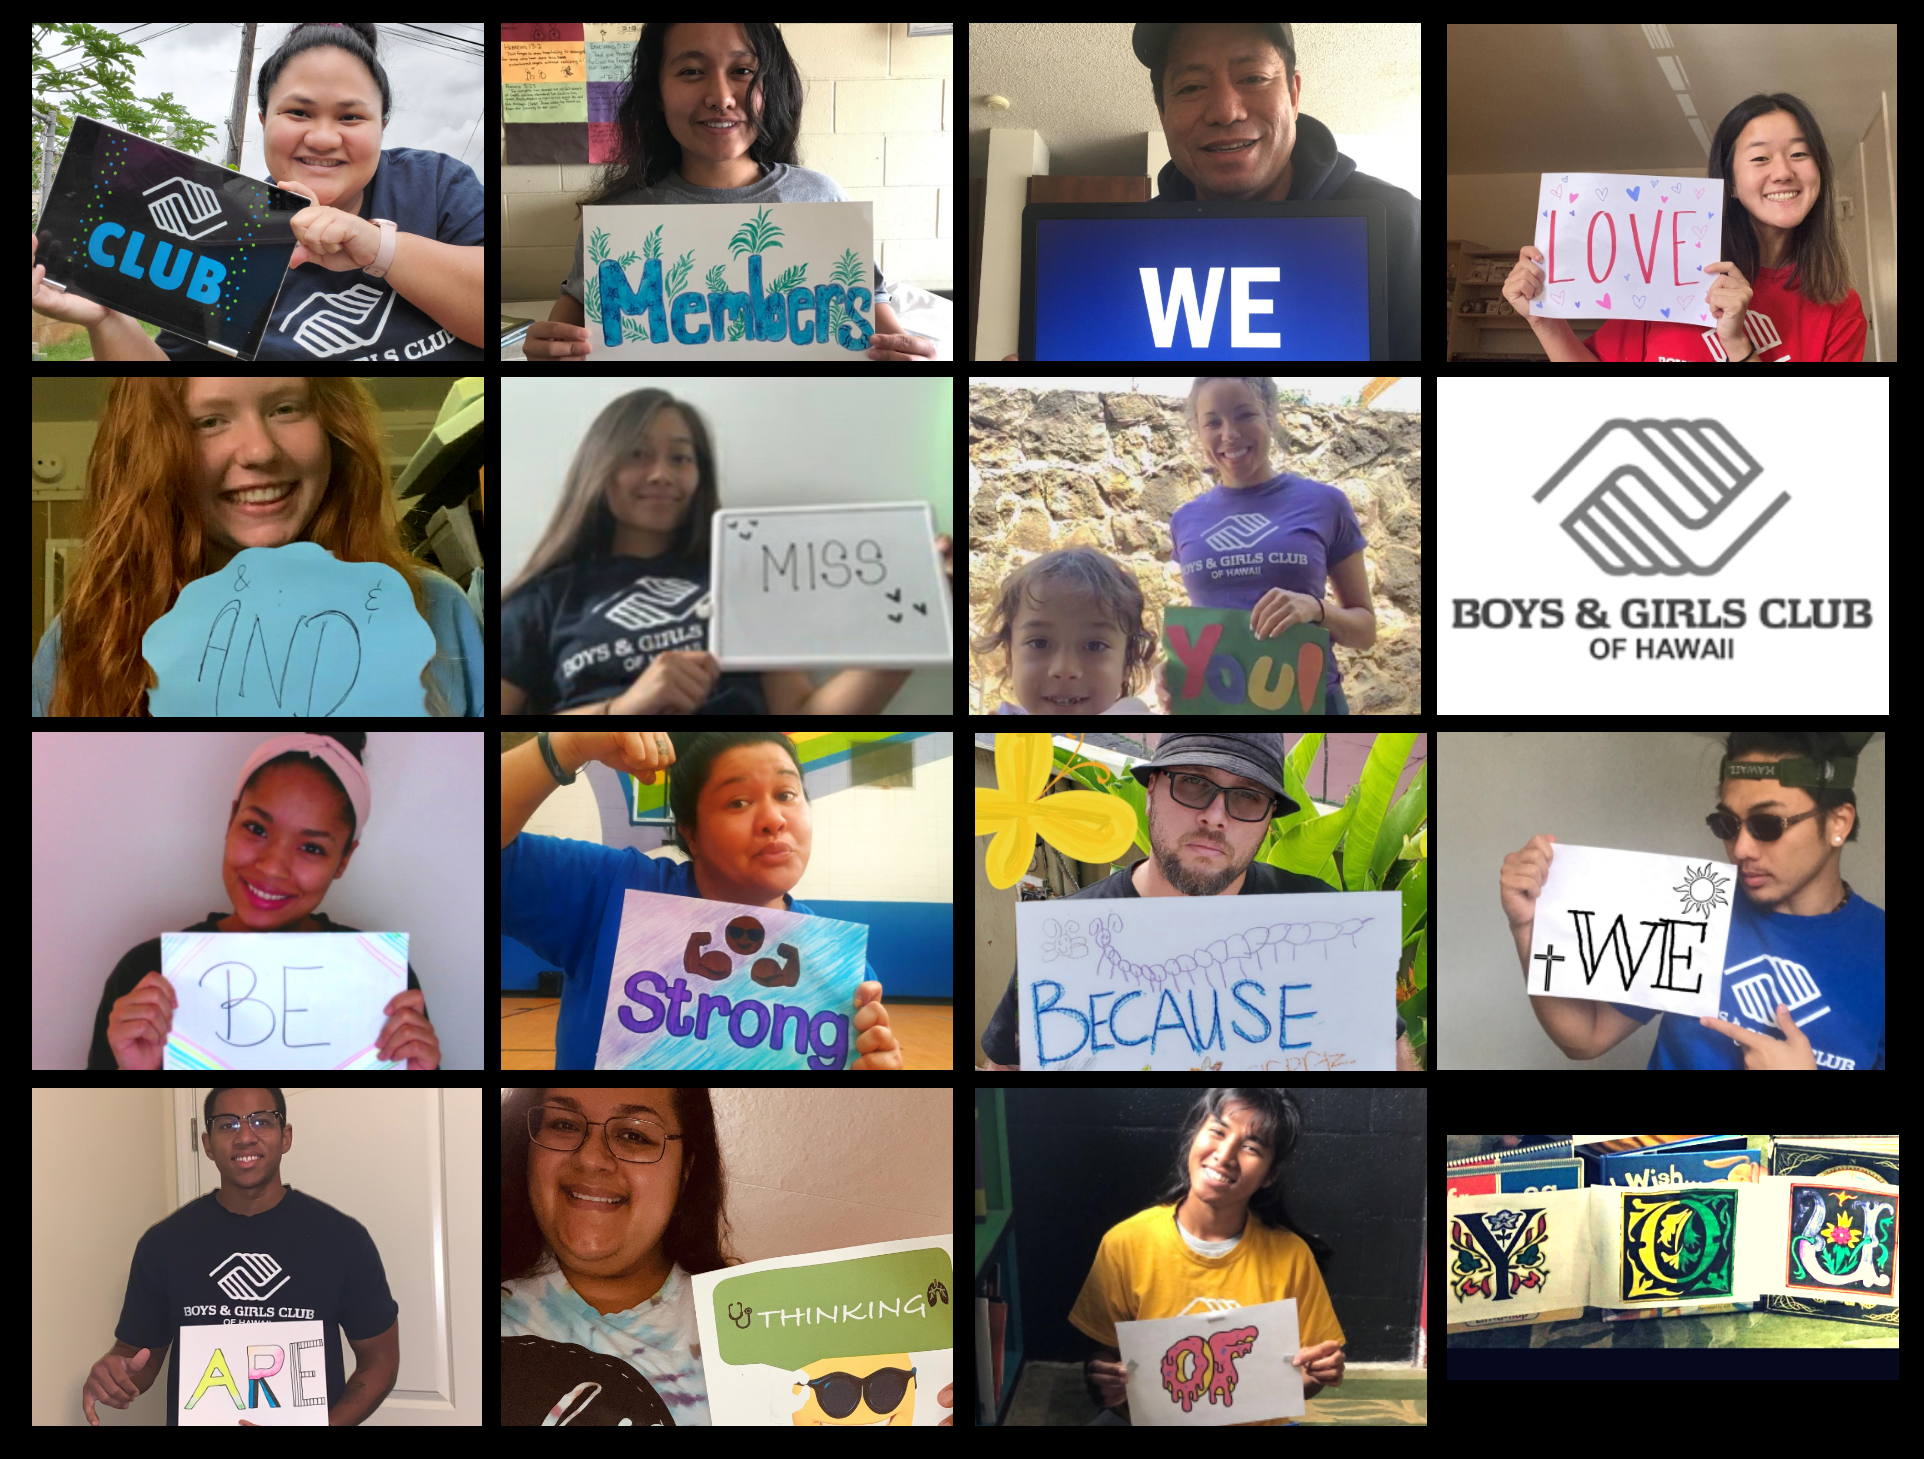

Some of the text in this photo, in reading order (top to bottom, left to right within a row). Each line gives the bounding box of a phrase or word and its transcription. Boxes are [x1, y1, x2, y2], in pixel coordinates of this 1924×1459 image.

[87, 221, 228, 306] CLUB
[1548, 209, 1700, 287] LOVE
[599, 254, 876, 352] Members
[1138, 266, 1282, 348] WE
[233, 563, 251, 591] &
[761, 538, 888, 593] MISS
[1205, 557, 1218, 570] &
[1220, 552, 1264, 567] GIRLS
[1268, 552, 1308, 565] CLUB
[1211, 565, 1261, 579] OF HAWAII
[1451, 597, 1873, 630] BOYS & GIRLS CLUB
[197, 598, 362, 717] AND
[561, 642, 611, 679] BOYS
[614, 637, 634, 655] &
[637, 623, 703, 652] GIRLS
[622, 654, 645, 672] OF
[1588, 637, 1735, 660] OF HAWAII
[1566, 908, 1708, 992] WE
[198, 960, 331, 1048] BE
[617, 970, 850, 1070] Strong
[1030, 978, 1318, 1069] BECAUSE
[183, 1304, 315, 1320] BOYS & GIRLS CLUB
[757, 1294, 928, 1329] THINKING
[183, 1338, 326, 1411] ARE
